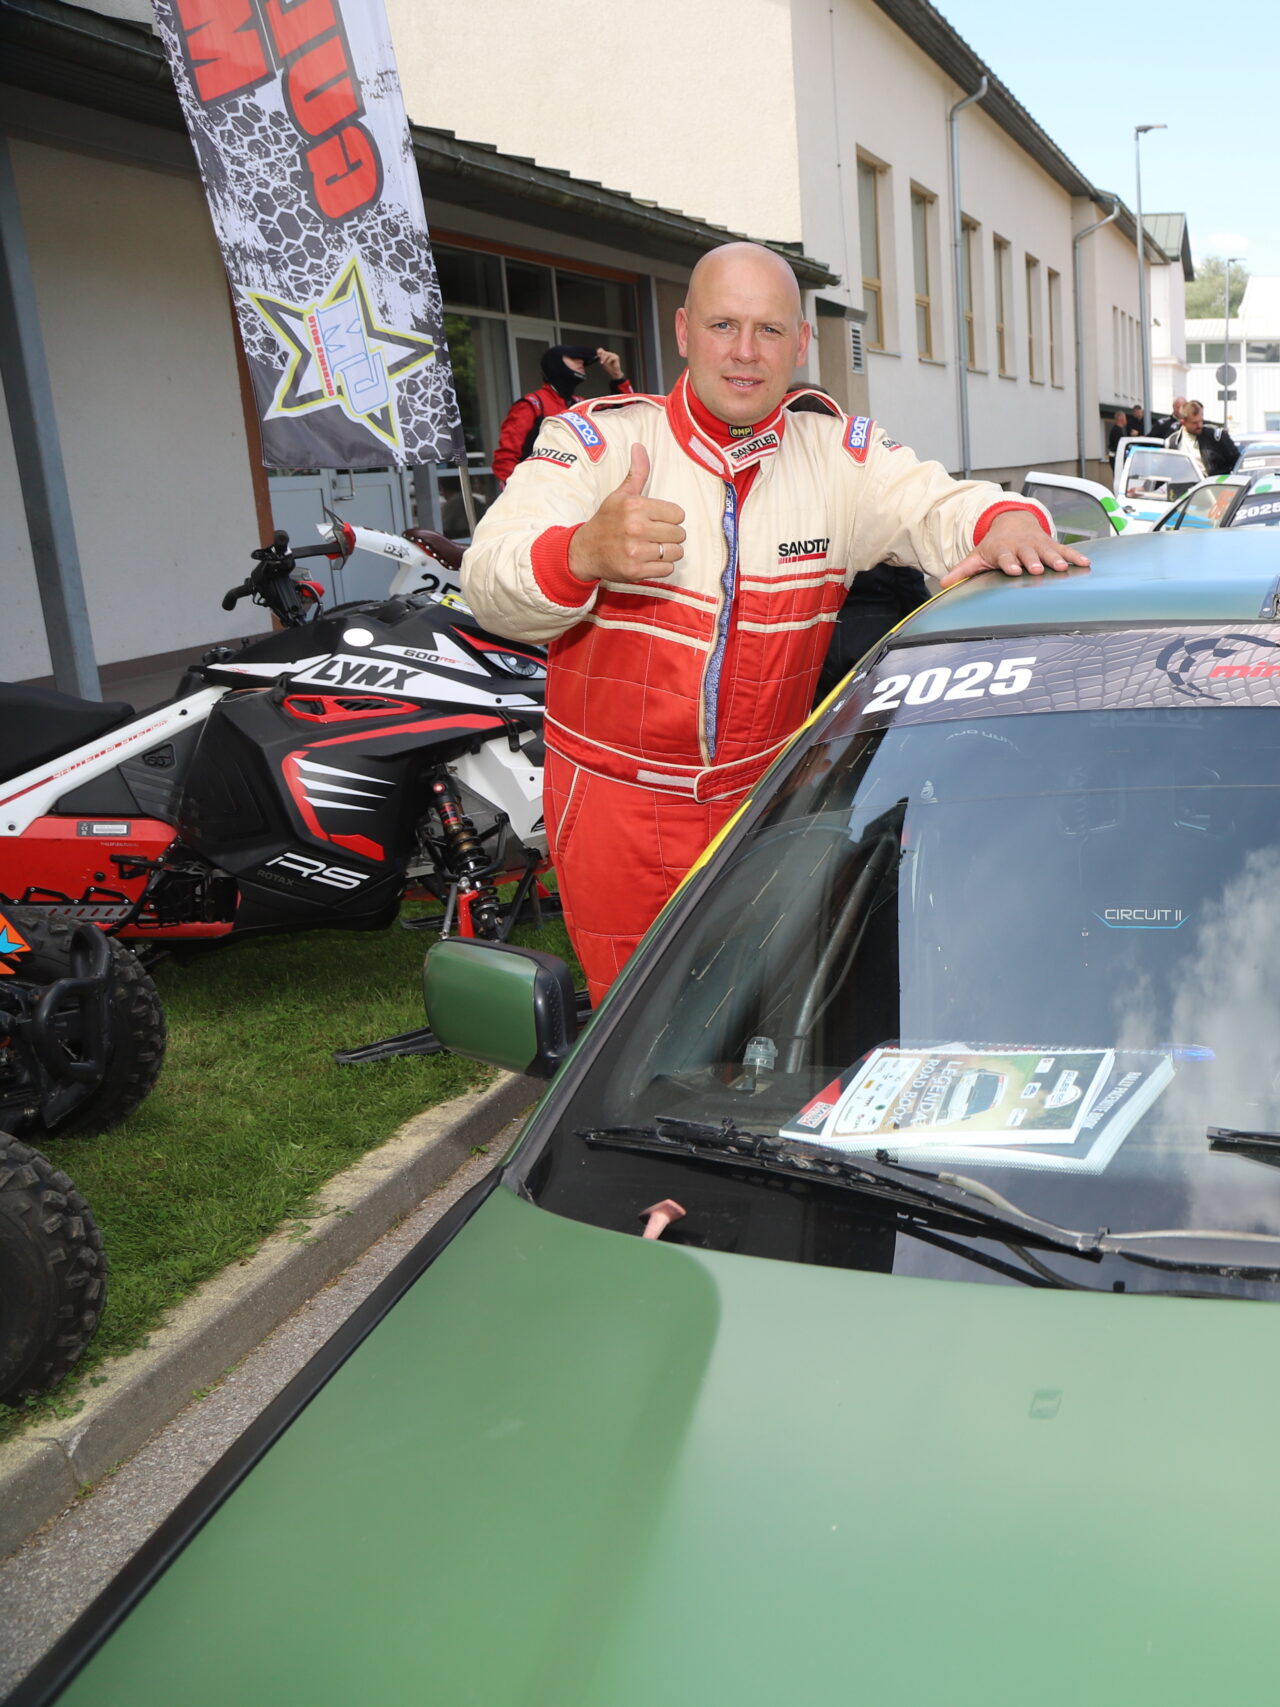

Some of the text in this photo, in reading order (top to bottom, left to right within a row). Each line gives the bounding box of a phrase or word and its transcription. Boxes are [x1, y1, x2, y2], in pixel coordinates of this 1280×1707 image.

[558, 412, 599, 444] parco
[732, 428, 751, 436] OMP
[731, 433, 777, 459] SANDTLER
[403, 650, 439, 662] 600
[311, 659, 422, 691] LYNX
[862, 657, 1037, 715] 2025
[256, 869, 295, 887] ROTAX
[265, 852, 371, 890] RS
[1104, 908, 1172, 921] CIRCUIT
[887, 1059, 940, 1125] ROAD BOOK
